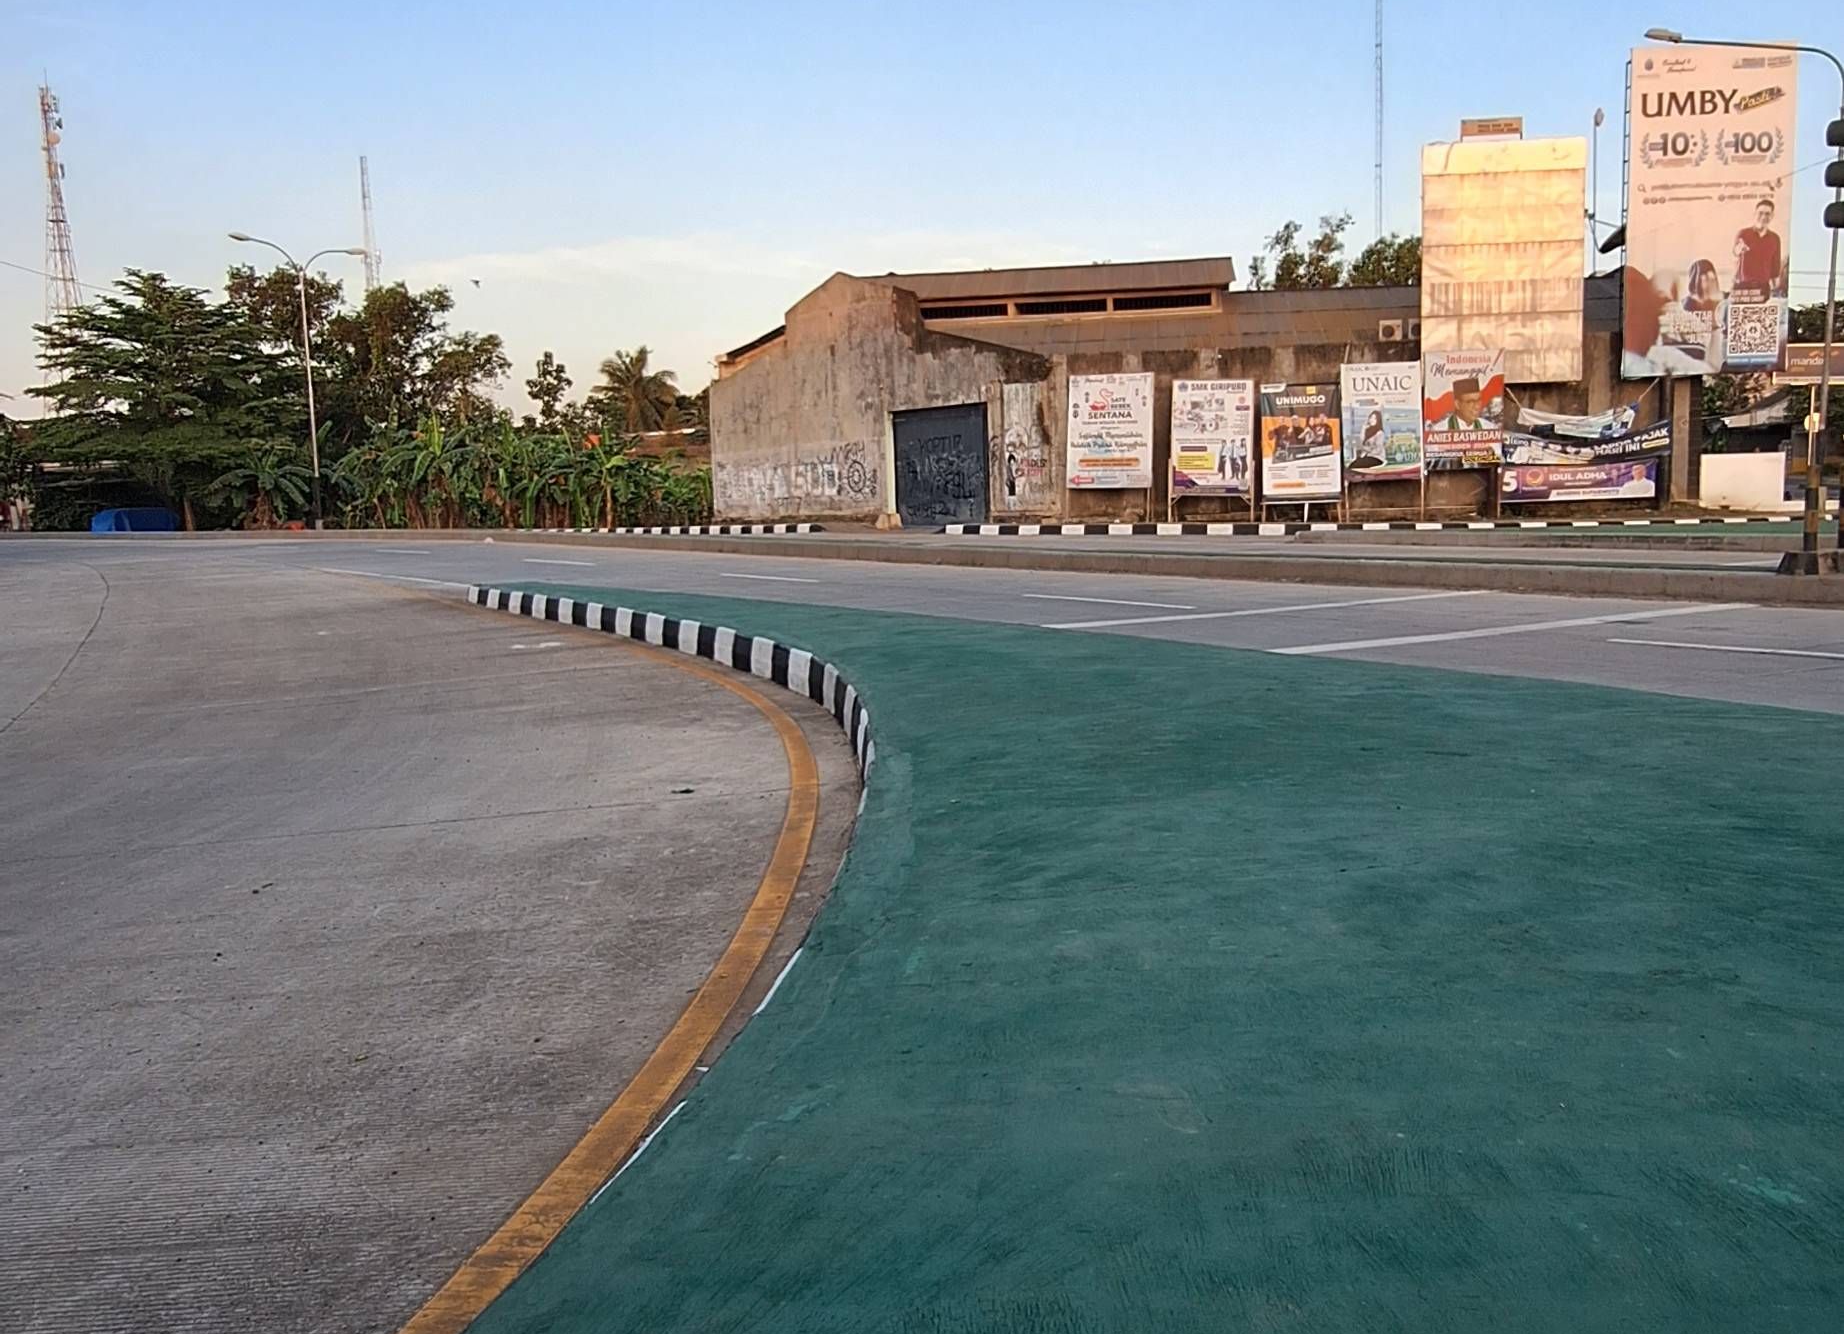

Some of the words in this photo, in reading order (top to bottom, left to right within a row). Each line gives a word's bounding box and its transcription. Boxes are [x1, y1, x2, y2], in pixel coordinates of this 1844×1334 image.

[1641, 89, 1738, 118] UMBY
[1352, 375, 1412, 392] UNAIC
[1275, 395, 1326, 405] UNIMUGO
[1088, 411, 1133, 420] SENTANA
[1427, 433, 1452, 443] ANIES
[1453, 430, 1501, 442] BASWEDAN
[1502, 471, 1518, 492] 5
[1549, 473, 1575, 481] IDUL
[1576, 471, 1607, 480] ADHA
